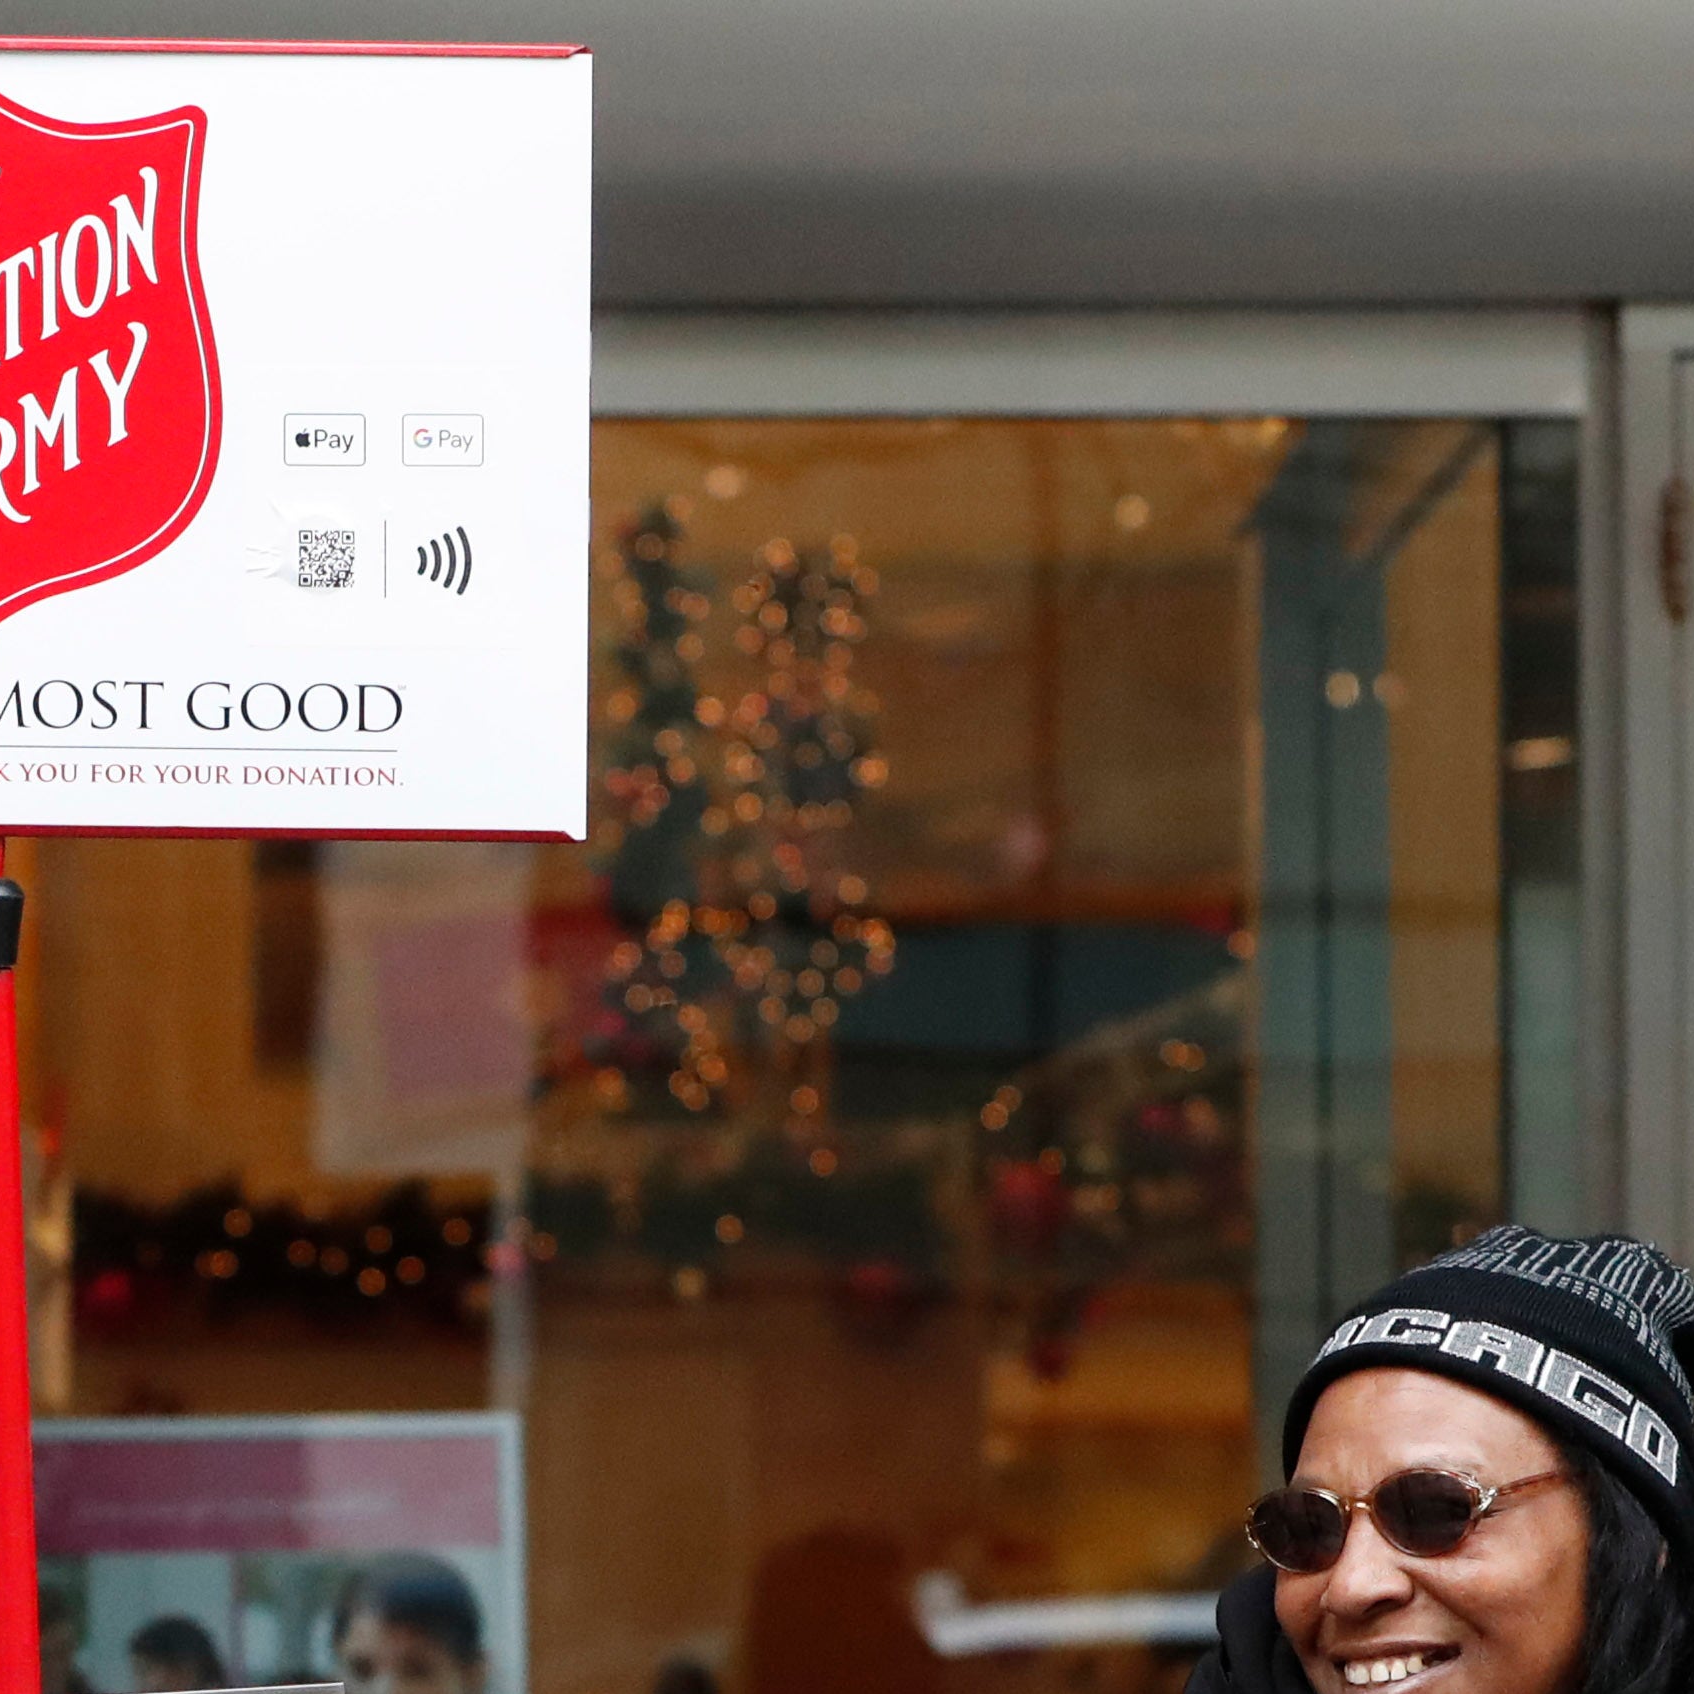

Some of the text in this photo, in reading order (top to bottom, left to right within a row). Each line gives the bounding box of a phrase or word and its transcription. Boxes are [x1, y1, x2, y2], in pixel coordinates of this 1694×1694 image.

[314, 428, 354, 454] Pay
[438, 429, 474, 453] Pay
[186, 681, 403, 733] GOOD
[19, 763, 78, 783] YOU
[91, 763, 146, 784] FOR
[154, 764, 232, 785] YOUR
[243, 765, 405, 787] DONATION.
[1306, 1308, 1680, 1488] ICAGO
